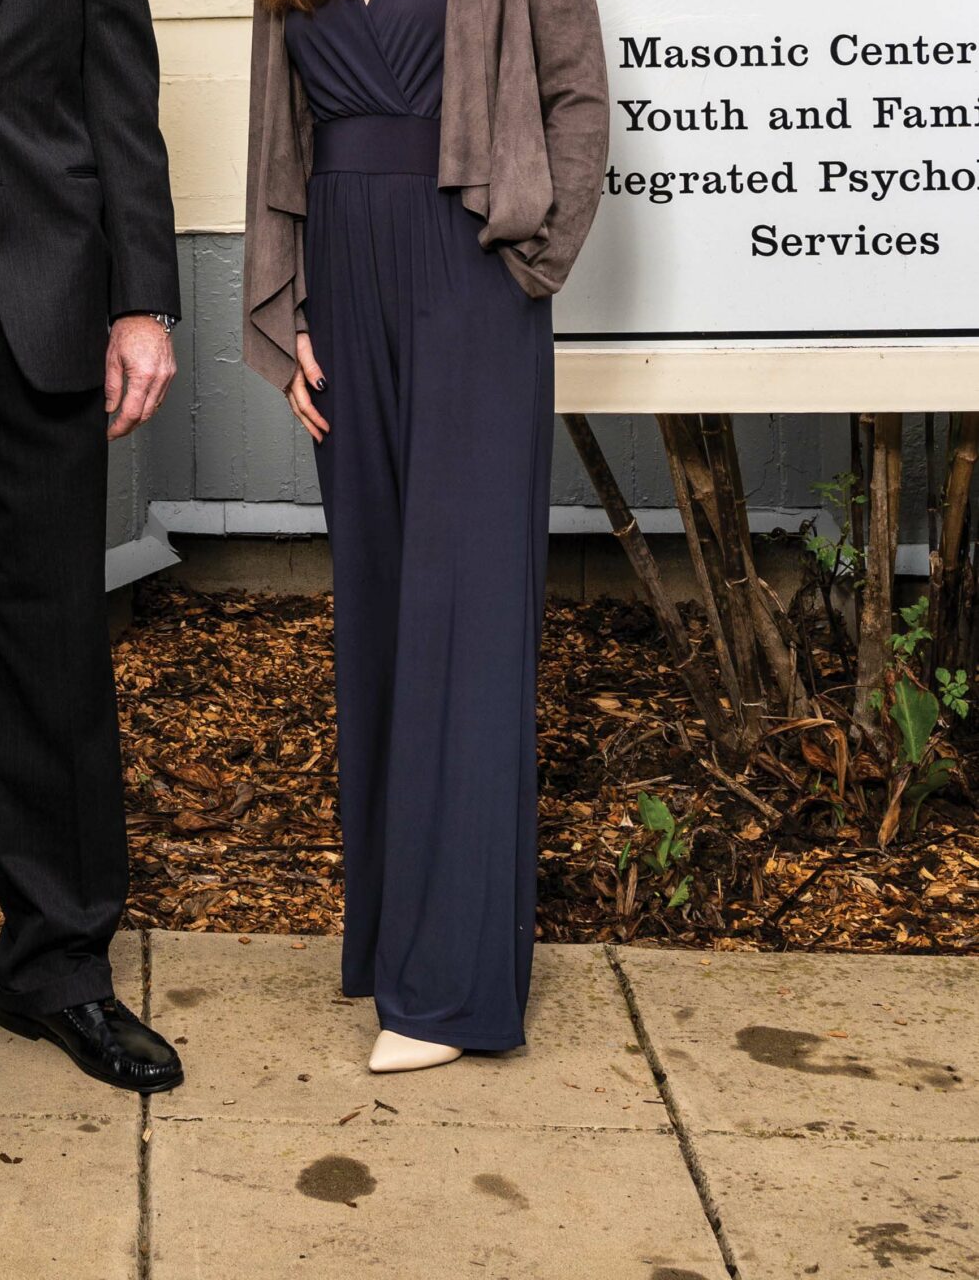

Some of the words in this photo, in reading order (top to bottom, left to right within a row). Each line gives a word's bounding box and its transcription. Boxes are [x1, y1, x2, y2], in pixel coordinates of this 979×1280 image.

[618, 35, 810, 69] Masonic
[830, 33, 978, 66] Center
[617, 99, 749, 132] Youth
[768, 97, 852, 131] and
[601, 161, 799, 205] tegrated
[818, 159, 979, 202] Psycho
[751, 224, 941, 257] Services
